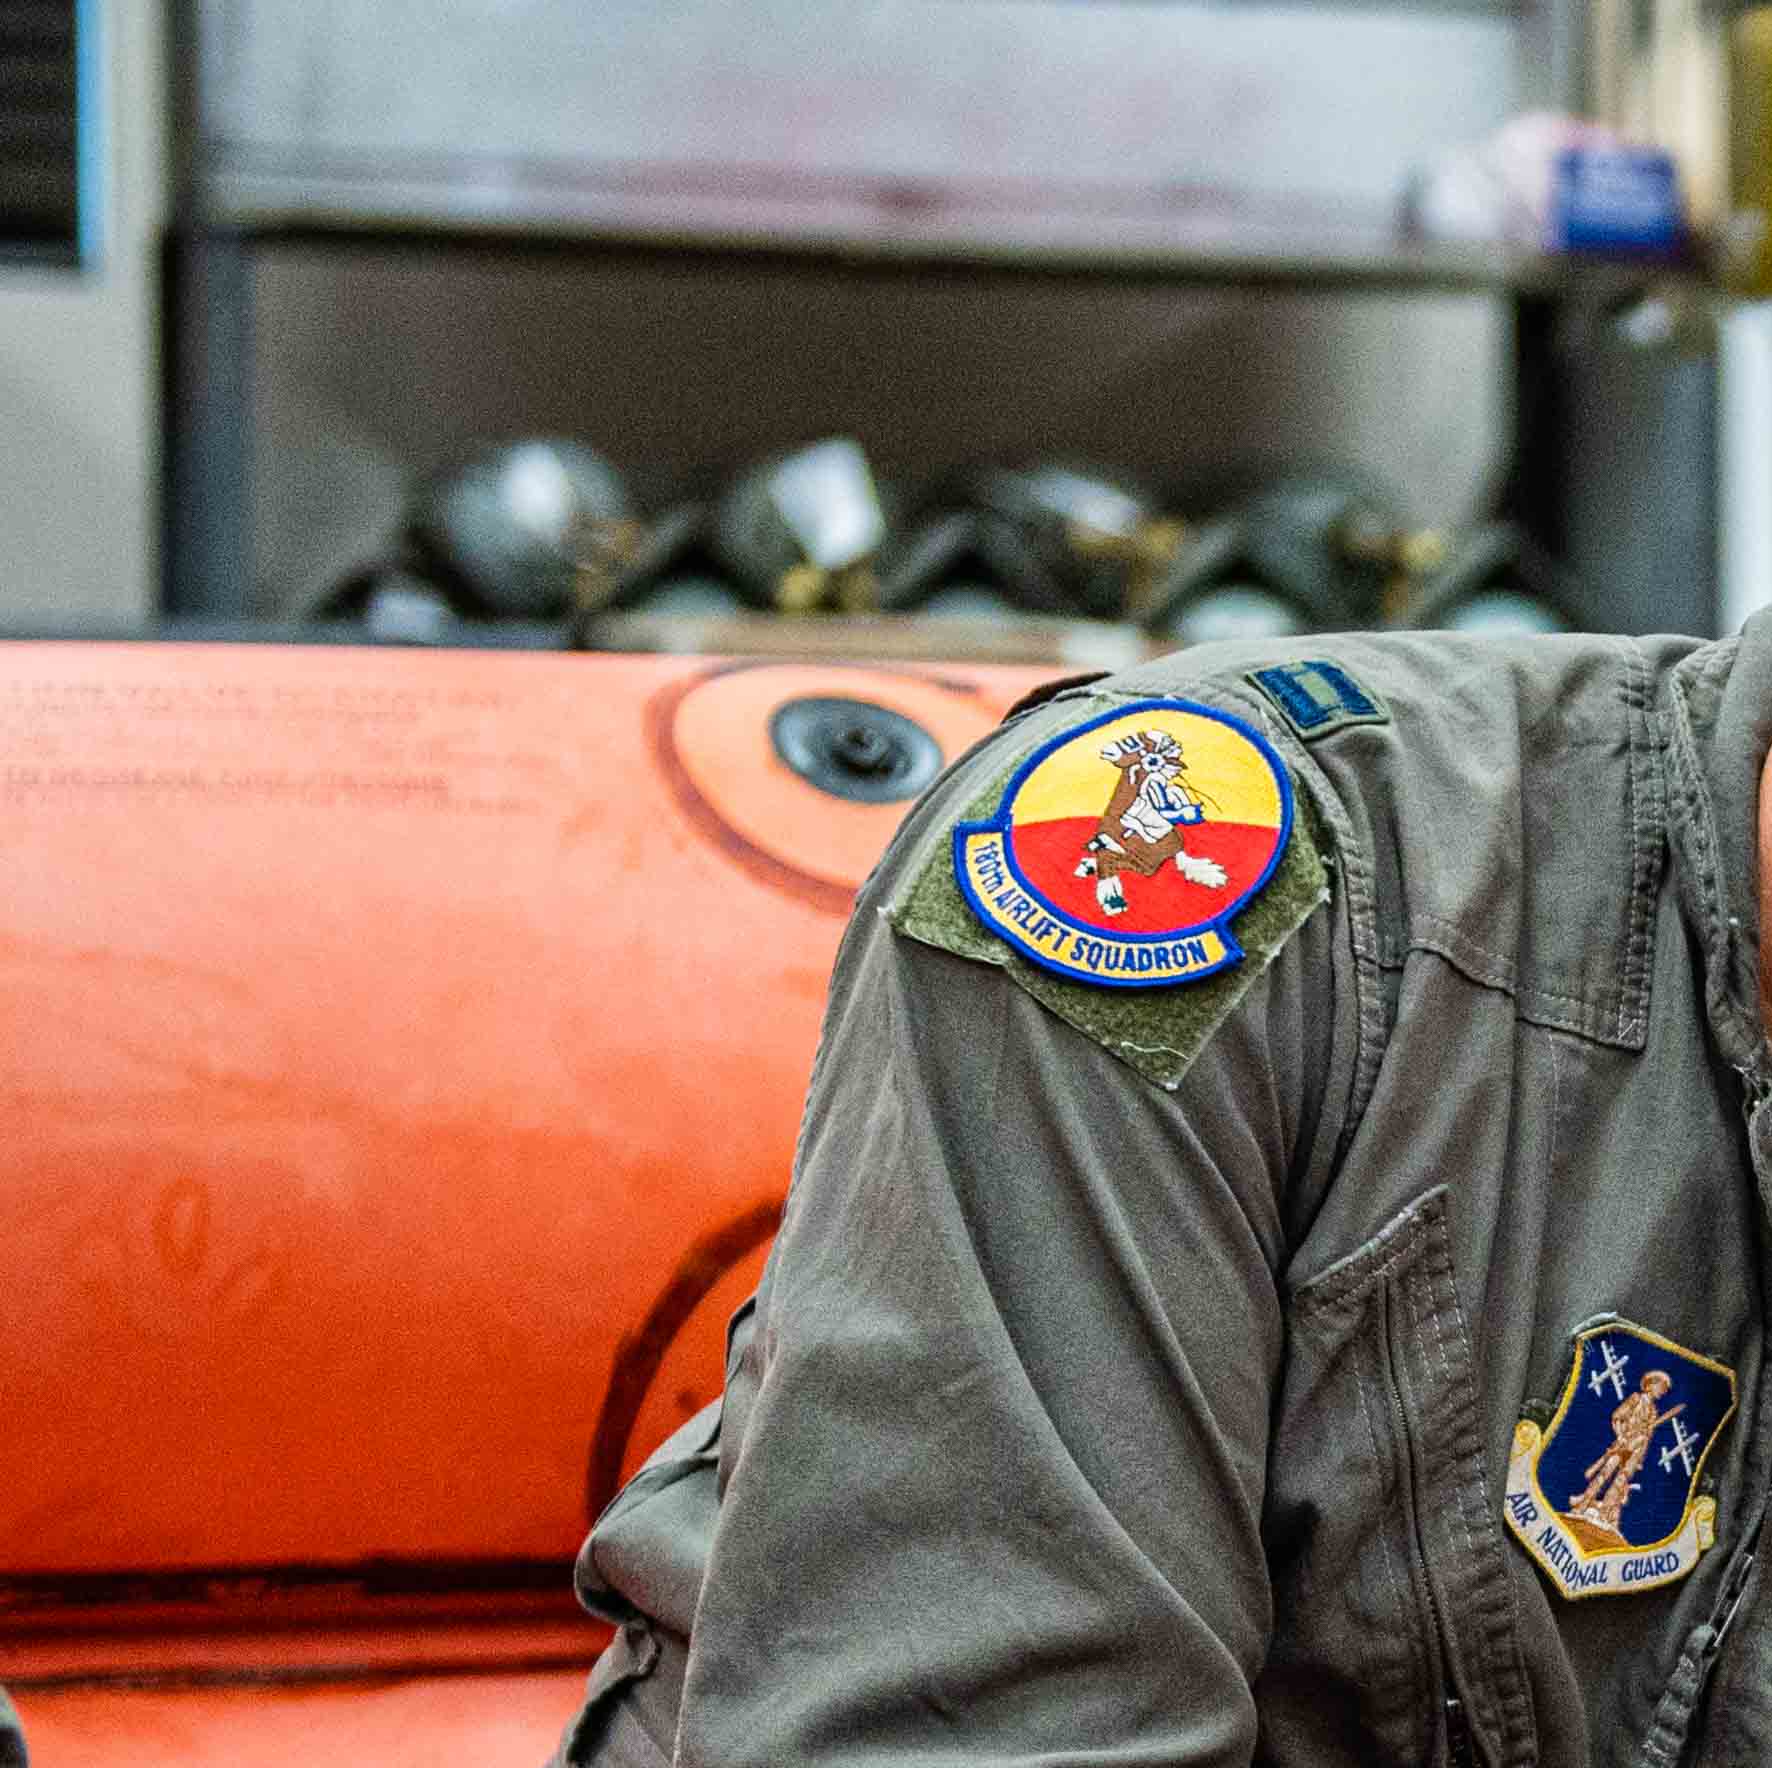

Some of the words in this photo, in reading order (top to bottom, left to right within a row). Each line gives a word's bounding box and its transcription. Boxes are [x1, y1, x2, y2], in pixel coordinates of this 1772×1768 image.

[992, 886, 1071, 953] AIRLIFT
[1069, 935, 1210, 973] SQUADRON
[1507, 1491, 1539, 1527] AIR
[1536, 1525, 1608, 1591] NATIONAL
[1620, 1550, 1680, 1583] GUARD
